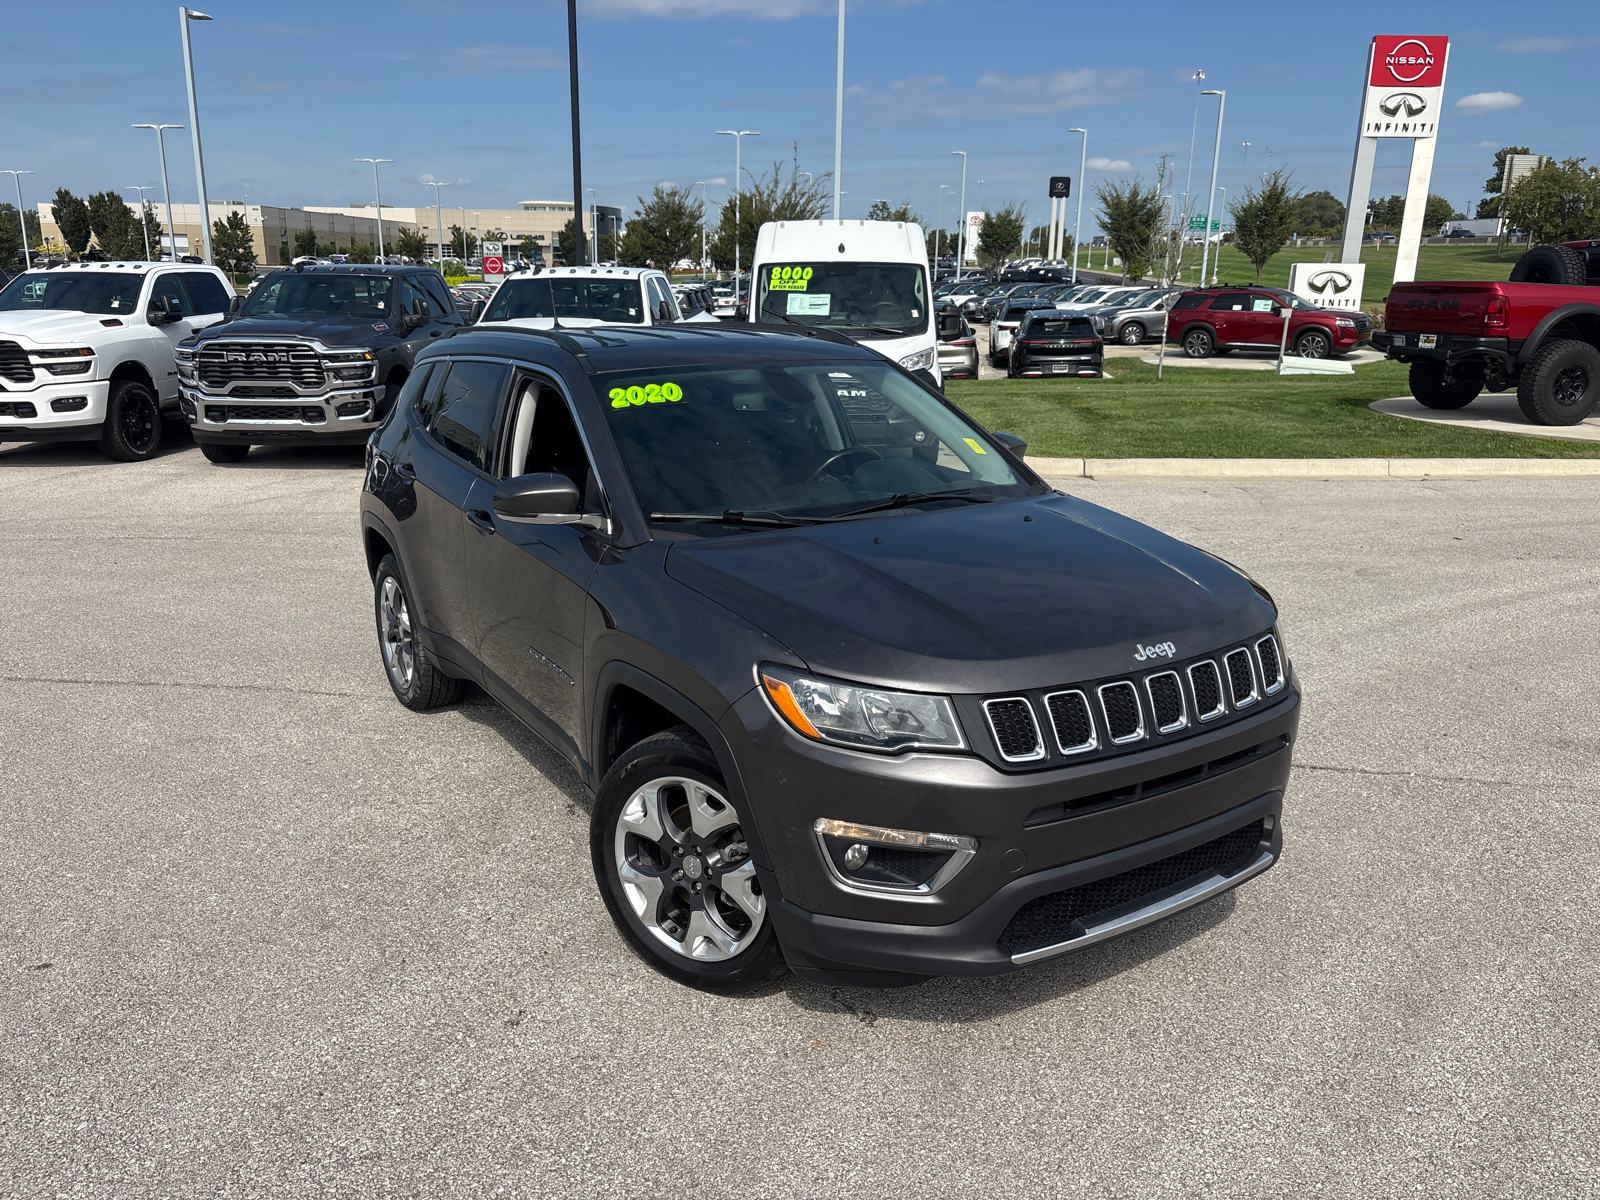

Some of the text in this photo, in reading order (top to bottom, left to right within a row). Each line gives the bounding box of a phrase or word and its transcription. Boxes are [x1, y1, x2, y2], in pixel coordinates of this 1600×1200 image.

[1386, 57, 1434, 65] NISSAN
[1366, 122, 1434, 133] INFINITI
[771, 266, 813, 280] 8000
[1306, 299, 1356, 307] FINITI
[1408, 300, 1460, 311] RAM
[226, 352, 288, 362] RAM
[609, 382, 683, 408] 2020
[837, 389, 866, 397] AM
[1132, 641, 1176, 661] Jeep
